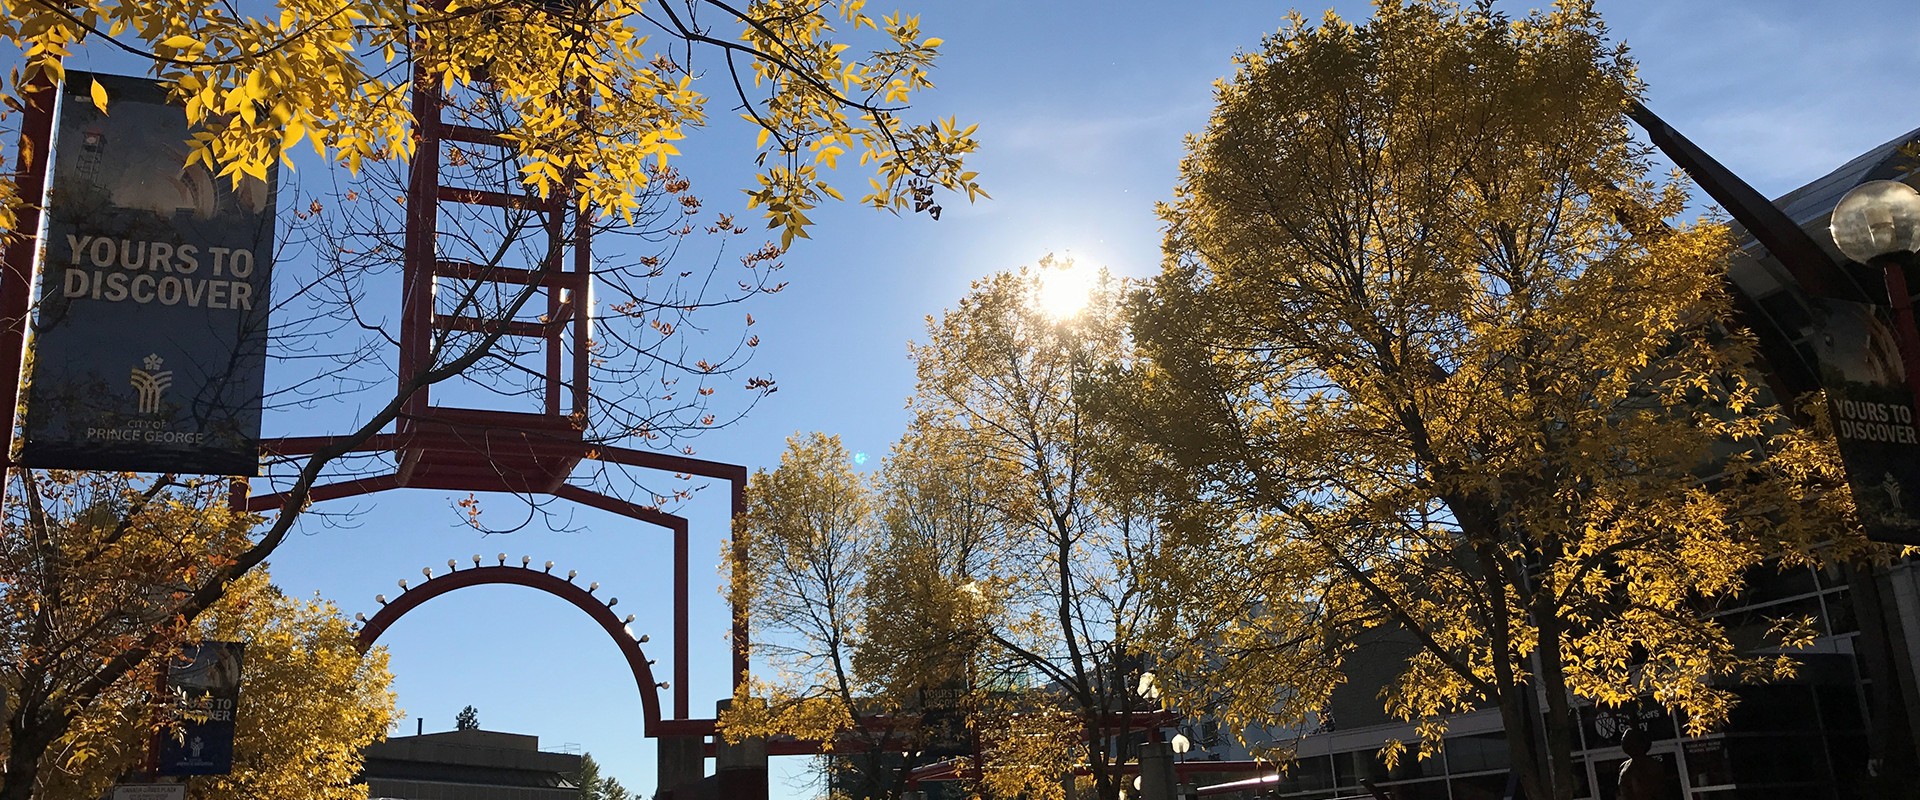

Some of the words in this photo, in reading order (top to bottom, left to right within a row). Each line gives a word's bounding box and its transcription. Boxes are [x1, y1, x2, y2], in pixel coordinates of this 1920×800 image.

[66, 234, 199, 274] YOURS
[208, 247, 254, 278] TO
[63, 268, 253, 311] DISCOVER
[1834, 398, 1889, 423] YOURS
[1890, 404, 1912, 424] TO
[87, 427, 141, 442] PRINCE
[144, 430, 203, 444] GEORGE
[127, 419, 151, 429] CITY
[152, 420, 167, 430] OF
[1840, 419, 1918, 444] DISCOVER
[216, 698, 232, 710] TO
